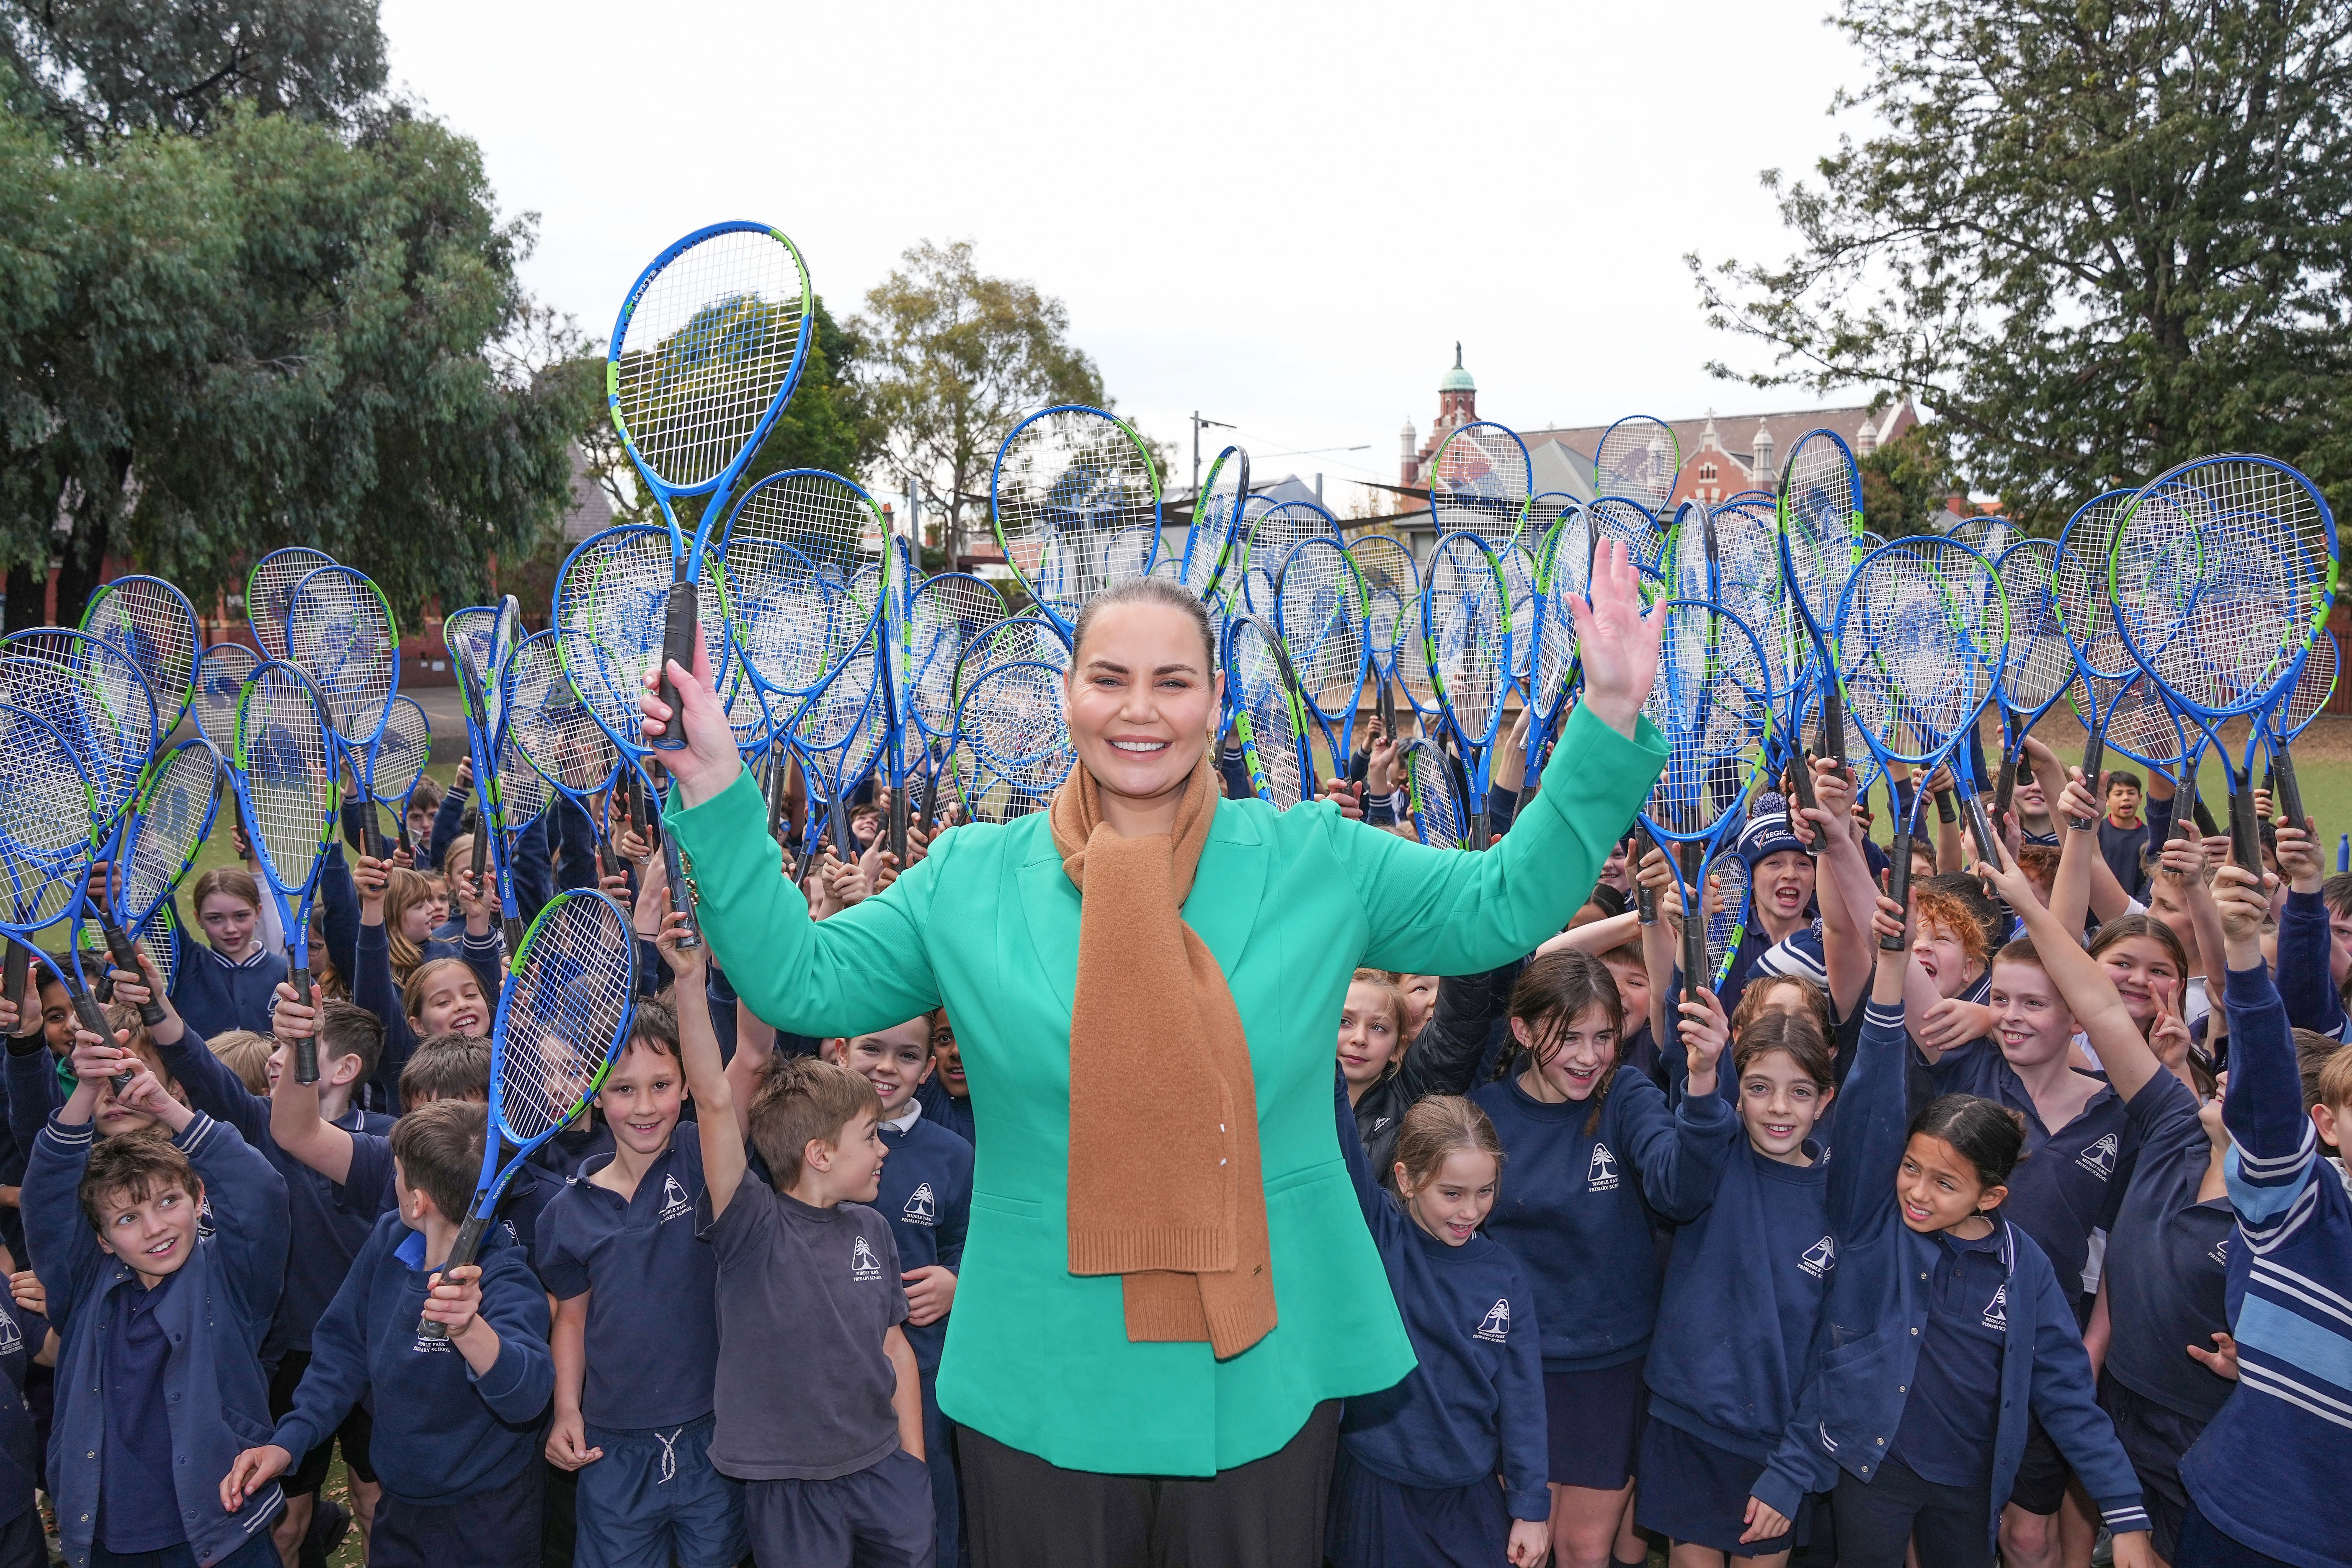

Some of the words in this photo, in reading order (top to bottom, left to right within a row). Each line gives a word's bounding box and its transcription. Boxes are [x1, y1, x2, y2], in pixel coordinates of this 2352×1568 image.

[632, 270, 657, 301] tennis
[699, 524, 712, 557] tennis
[1950, 763, 1961, 783] shots
[1762, 836, 1795, 846] CHAMPIONSHIPS
[1765, 829, 1794, 839] REGIO
[521, 926, 541, 957] shots
[509, 1166, 520, 1175] hot
[2075, 1159, 2093, 1173] PRIMARY
[2091, 1170, 2107, 1182] SCHOOL
[2081, 1157, 2097, 1169] MIDDLE
[2096, 1166, 2108, 1176] PARK
[492, 1179, 507, 1199] shots
[663, 1208, 677, 1218] MIDDLE
[677, 1203, 687, 1211] PARK
[677, 1206, 694, 1217] SCHOOL
[1803, 1260, 1821, 1272] MIDDLE
[2207, 1251, 2226, 1266] PRIMA
[1797, 1263, 1818, 1277] PRIMARY
[1982, 1321, 1999, 1330] PRIMARY
[1985, 1316, 2001, 1325] MIDDLE
